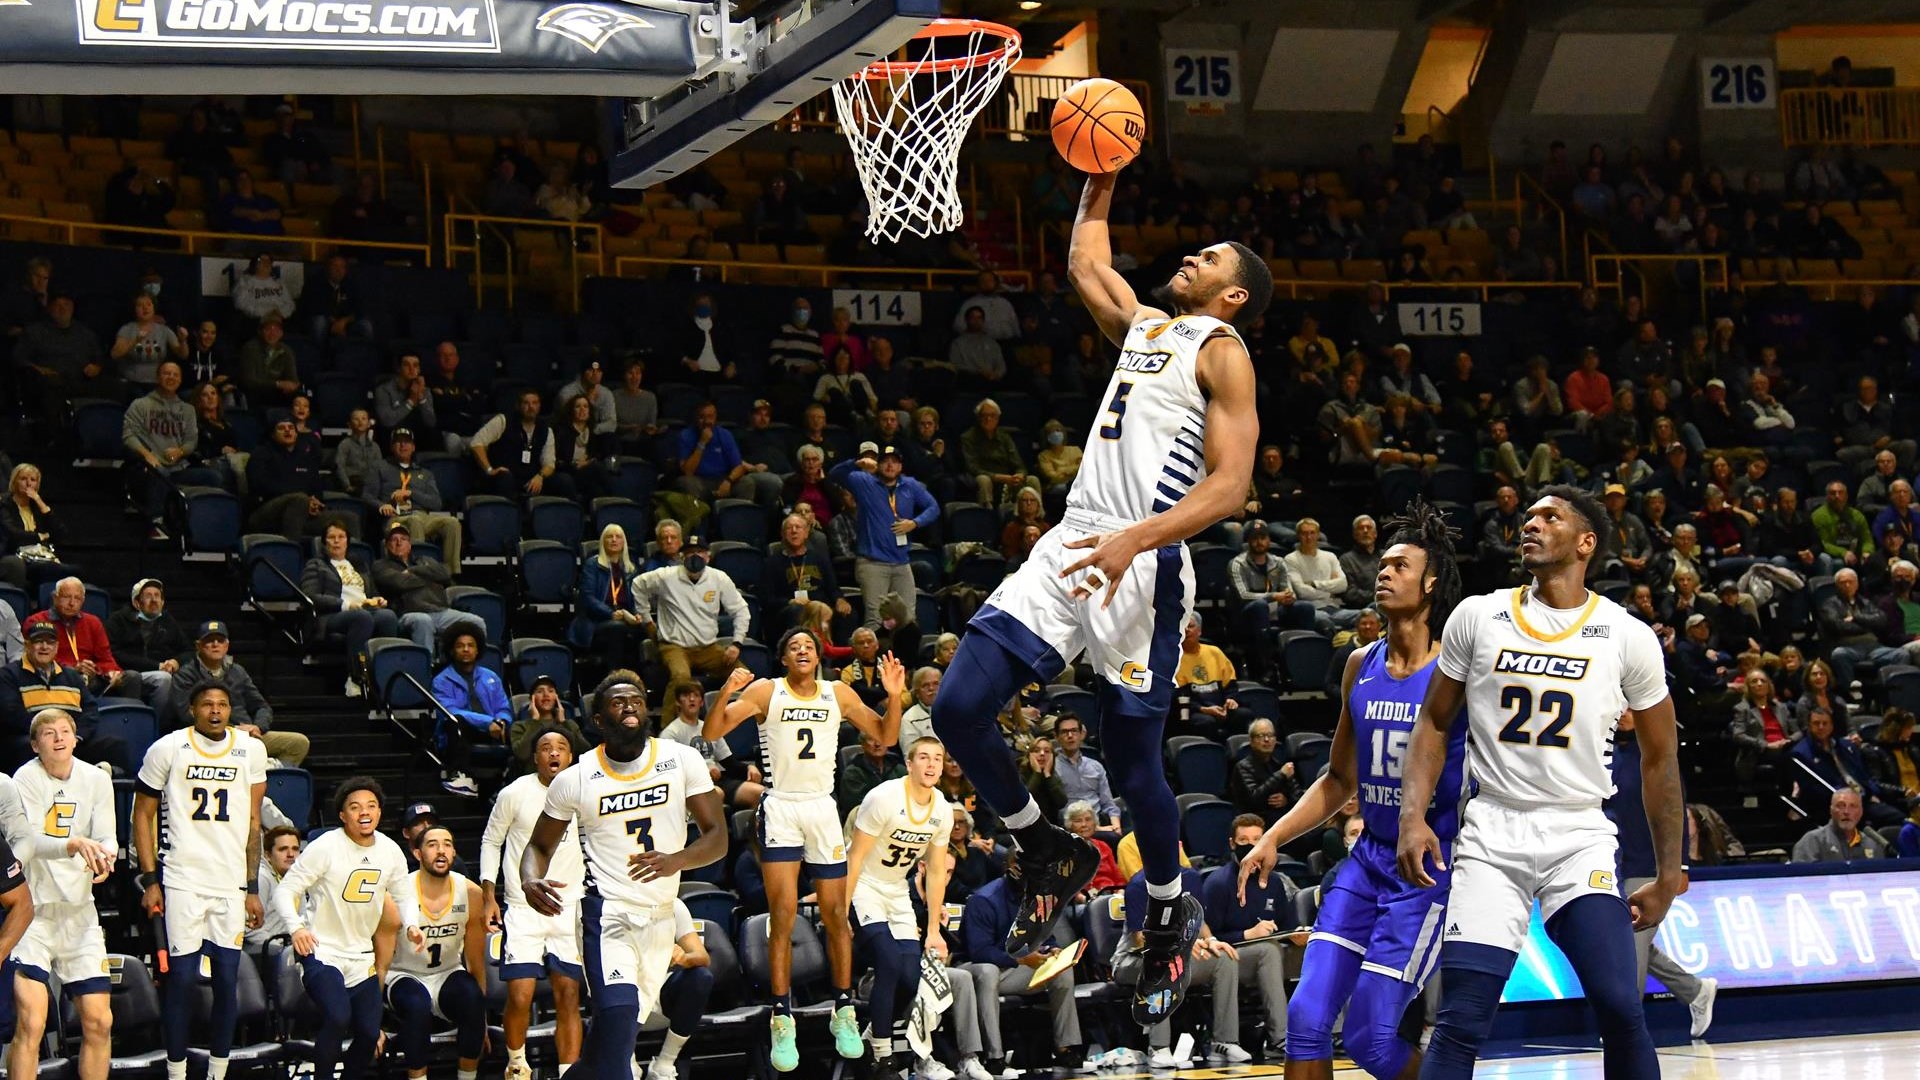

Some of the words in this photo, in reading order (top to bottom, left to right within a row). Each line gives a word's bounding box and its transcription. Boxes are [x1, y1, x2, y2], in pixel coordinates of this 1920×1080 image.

[1174, 55, 1232, 97] 215
[1711, 64, 1766, 104] 216
[850, 293, 904, 322] 114
[1413, 306, 1465, 332] 115
[1099, 381, 1135, 440] 5
[1582, 625, 1609, 638] SOCON
[1120, 661, 1147, 688] C
[1495, 650, 1590, 680] MOCS
[781, 707, 829, 722] MOCS
[1499, 685, 1575, 749] 22
[797, 728, 816, 760] 2
[1370, 729, 1411, 778] 15
[186, 765, 237, 782] MOCS
[192, 787, 230, 822] 21
[599, 784, 669, 816] MOCS
[44, 802, 77, 838] C
[625, 817, 655, 852] 3
[890, 829, 932, 844] MOCS
[881, 844, 920, 867] 35
[342, 869, 381, 903] C
[1589, 870, 1613, 890] C
[1658, 888, 1920, 974] CHATT
[427, 944, 441, 968] 1
